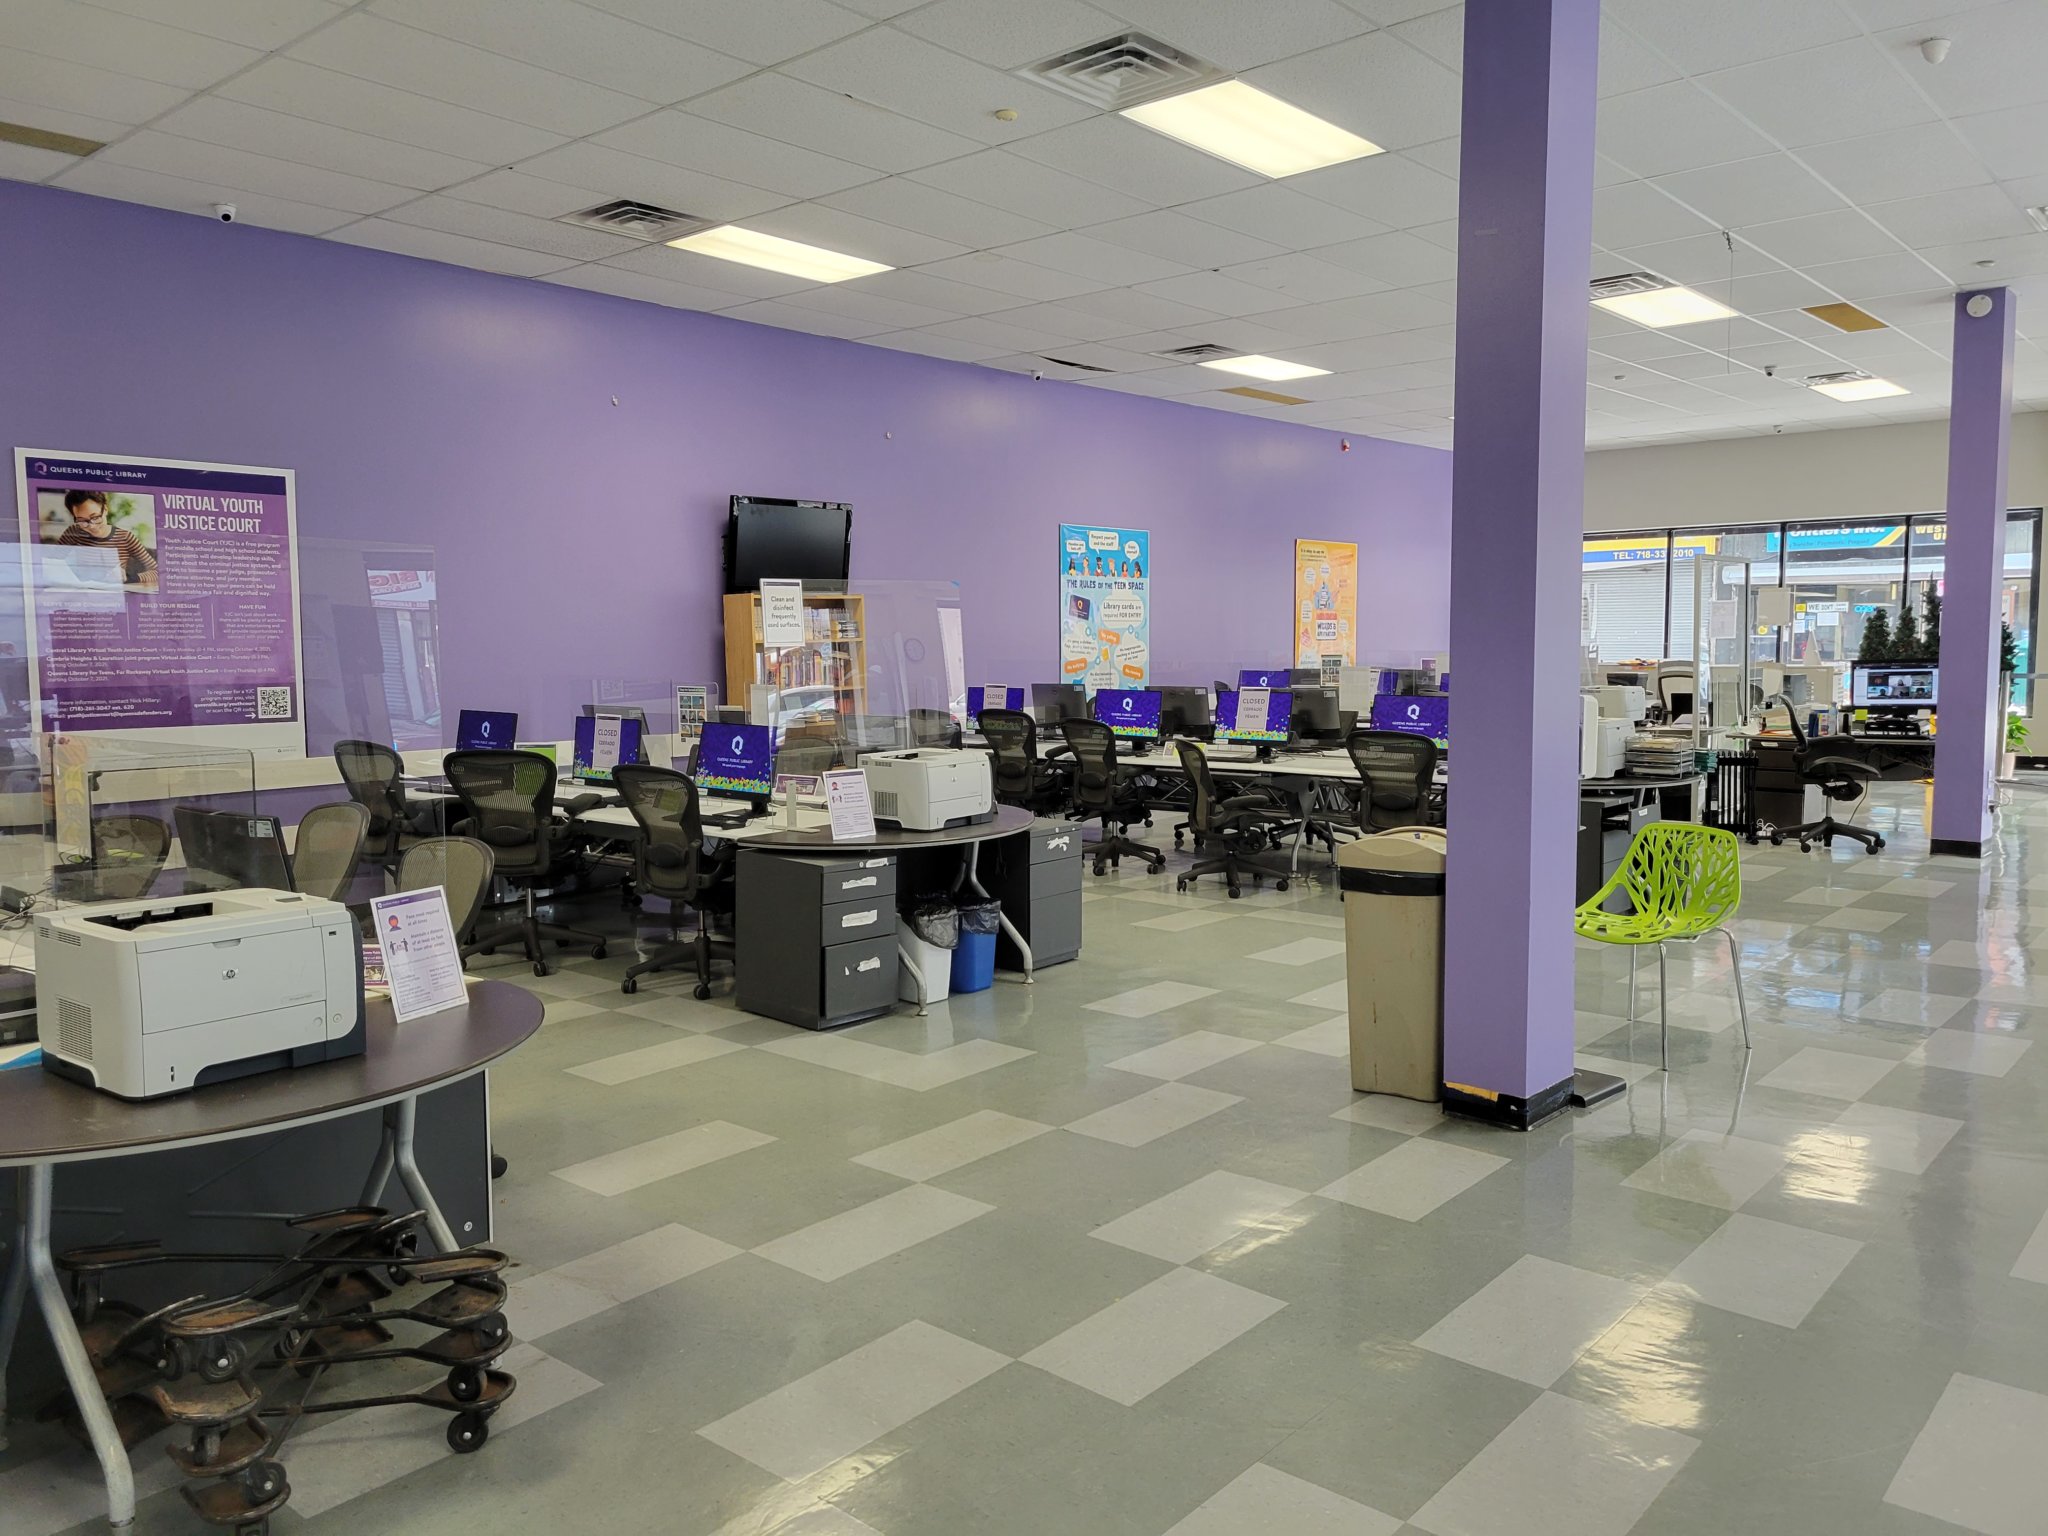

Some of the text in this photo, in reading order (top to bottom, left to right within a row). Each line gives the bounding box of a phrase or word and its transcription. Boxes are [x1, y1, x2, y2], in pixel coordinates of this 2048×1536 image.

[162, 494, 263, 514] VIRTUAL YOUTH
[164, 514, 261, 533] JUSTICE COURT
[1067, 580, 1077, 588] THE
[1080, 580, 1096, 589] RULES
[1128, 582, 1144, 590] SPACE
[1104, 602, 1120, 611] Library
